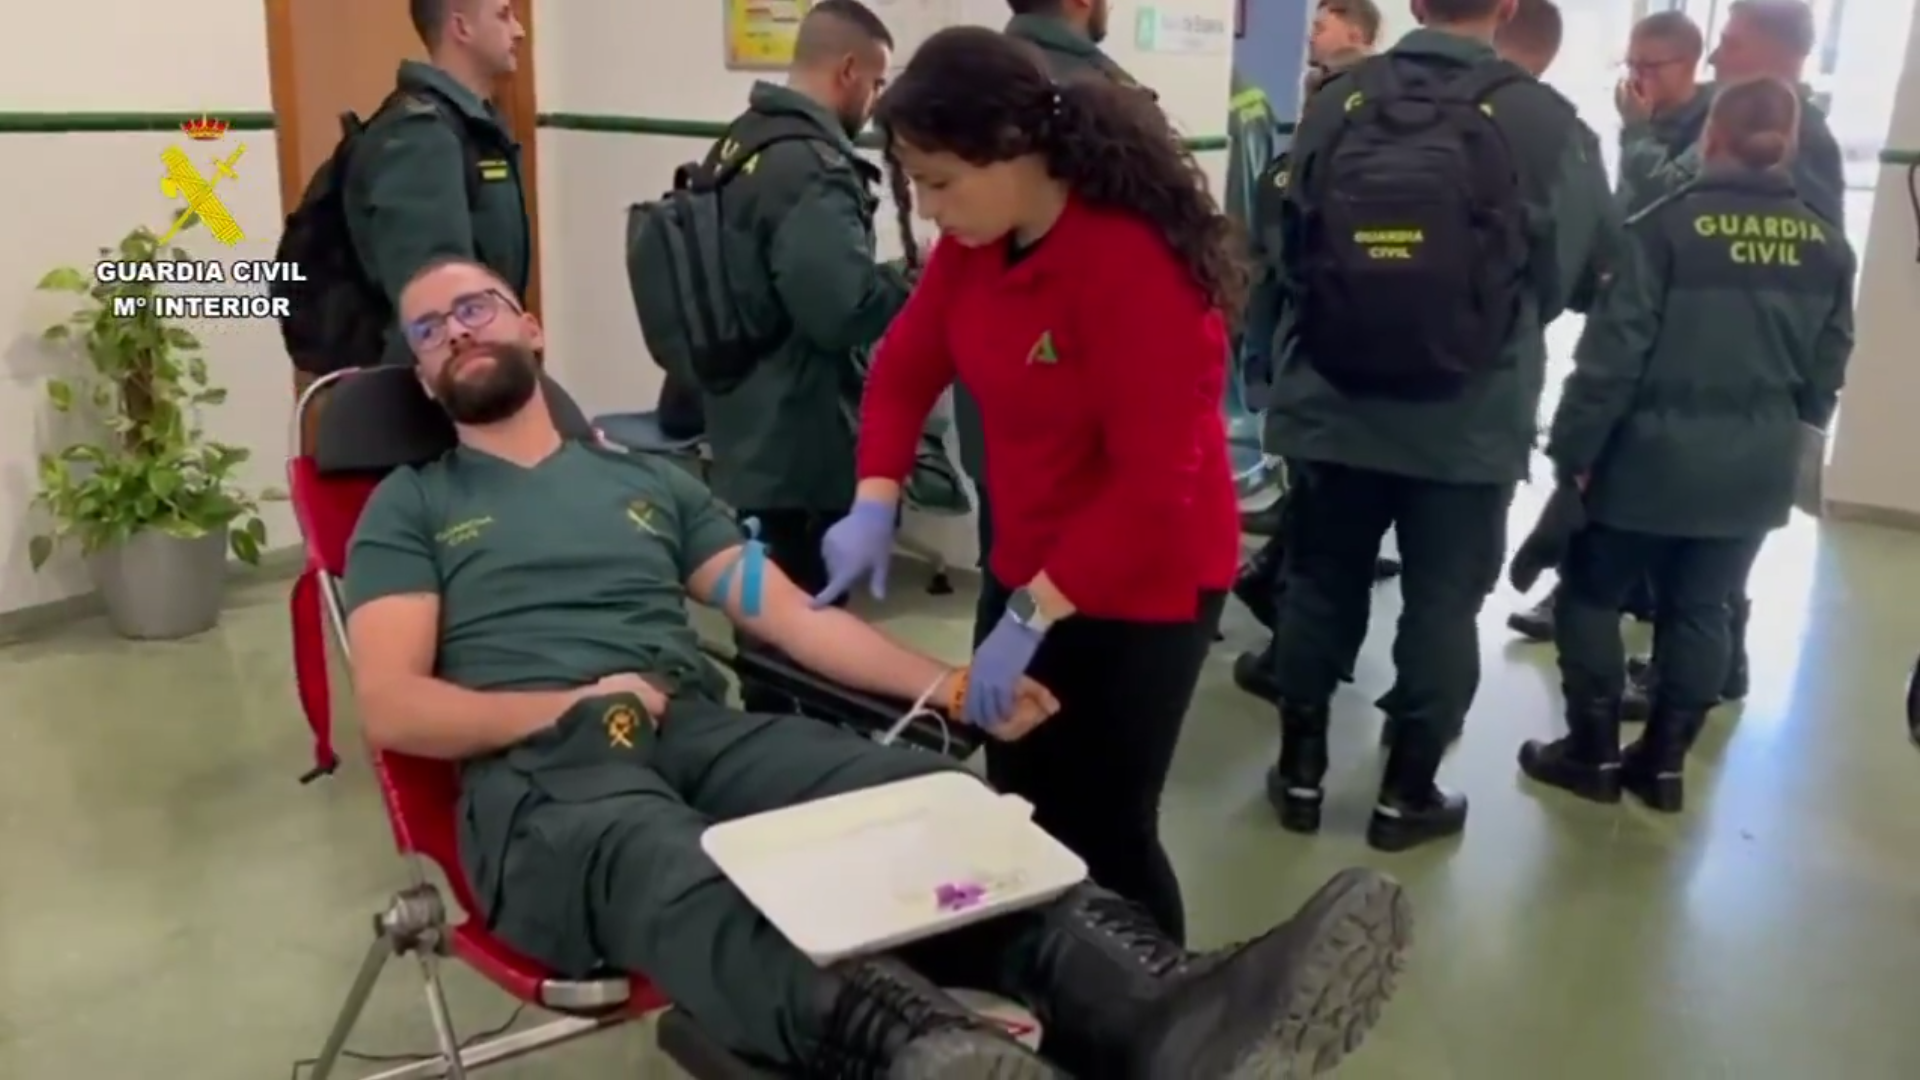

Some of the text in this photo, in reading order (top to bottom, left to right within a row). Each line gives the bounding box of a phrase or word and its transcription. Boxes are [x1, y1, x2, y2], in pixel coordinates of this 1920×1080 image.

[1353, 229, 1424, 243] GUARDIA
[1694, 214, 1826, 244] GUARDIA
[1369, 246, 1412, 259] CIVIL
[1730, 241, 1801, 267] CIVIL
